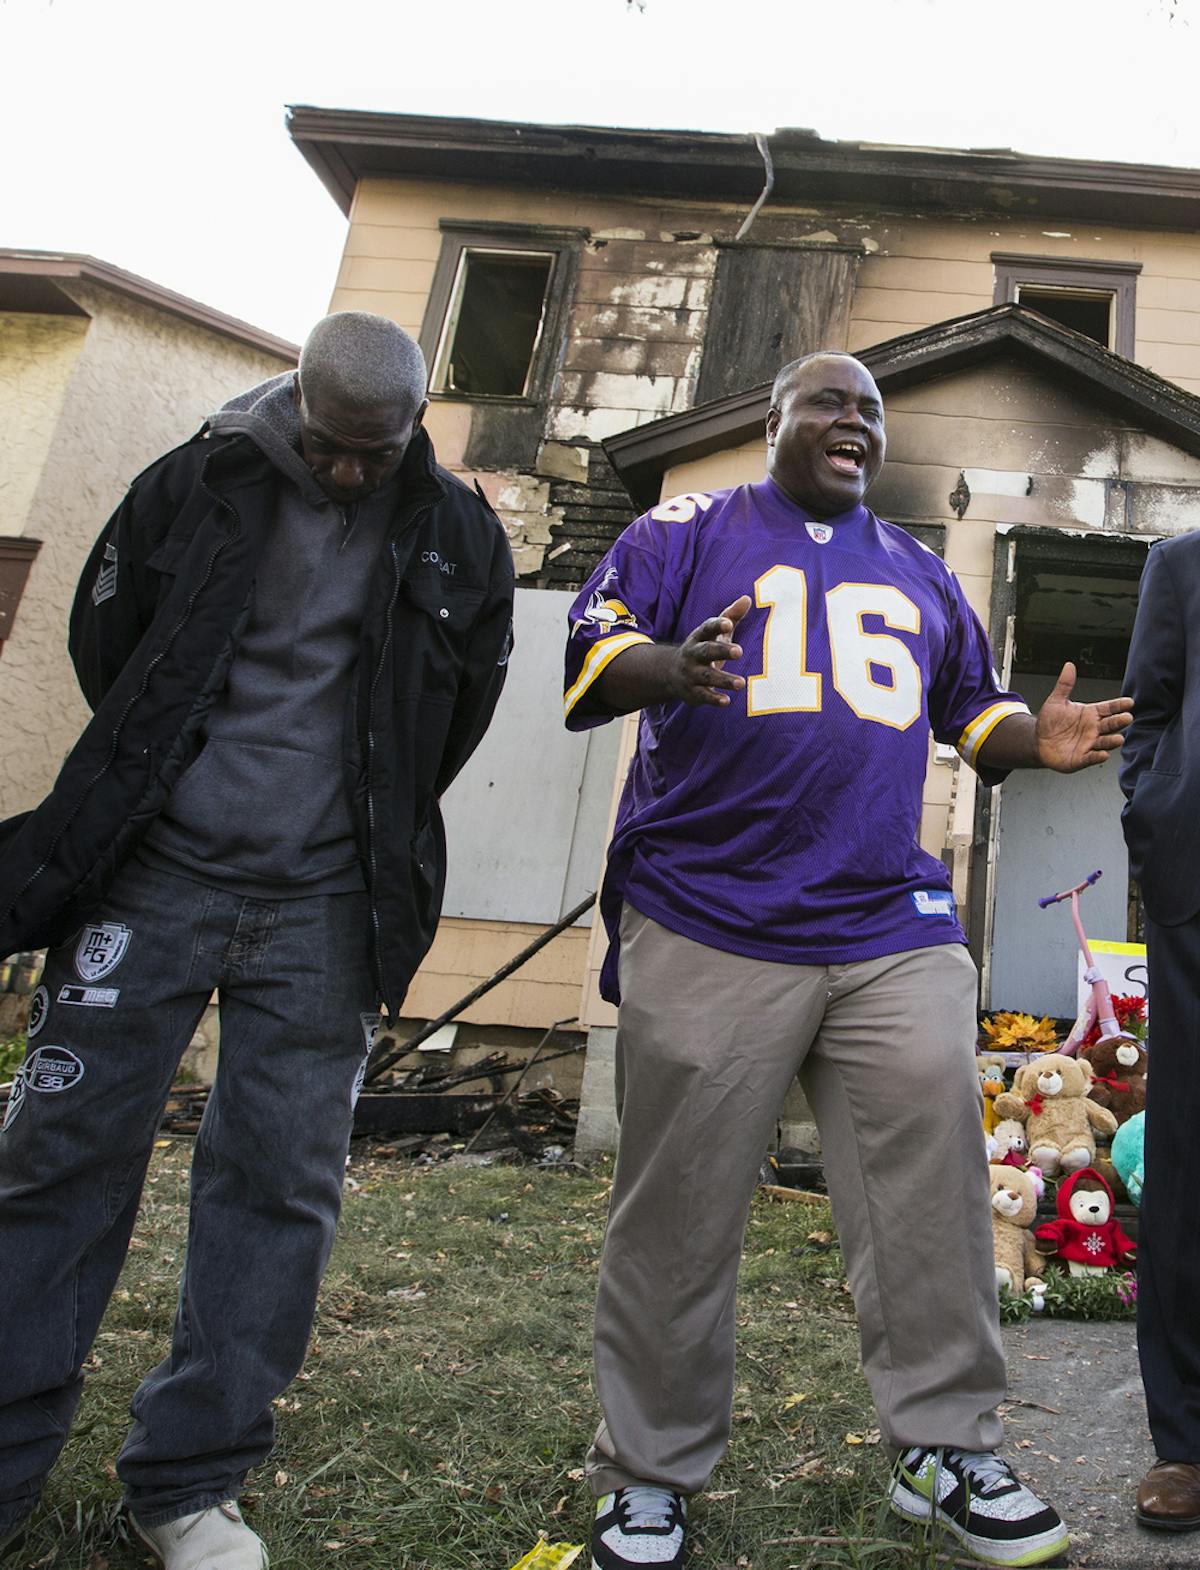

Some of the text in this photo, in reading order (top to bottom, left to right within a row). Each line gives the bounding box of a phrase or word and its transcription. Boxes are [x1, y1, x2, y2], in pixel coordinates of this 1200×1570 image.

[421, 551, 457, 575] COAT
[747, 564, 922, 731] 16
[37, 1061, 76, 1074] GIRBAUD
[38, 1075, 65, 1089] 38
